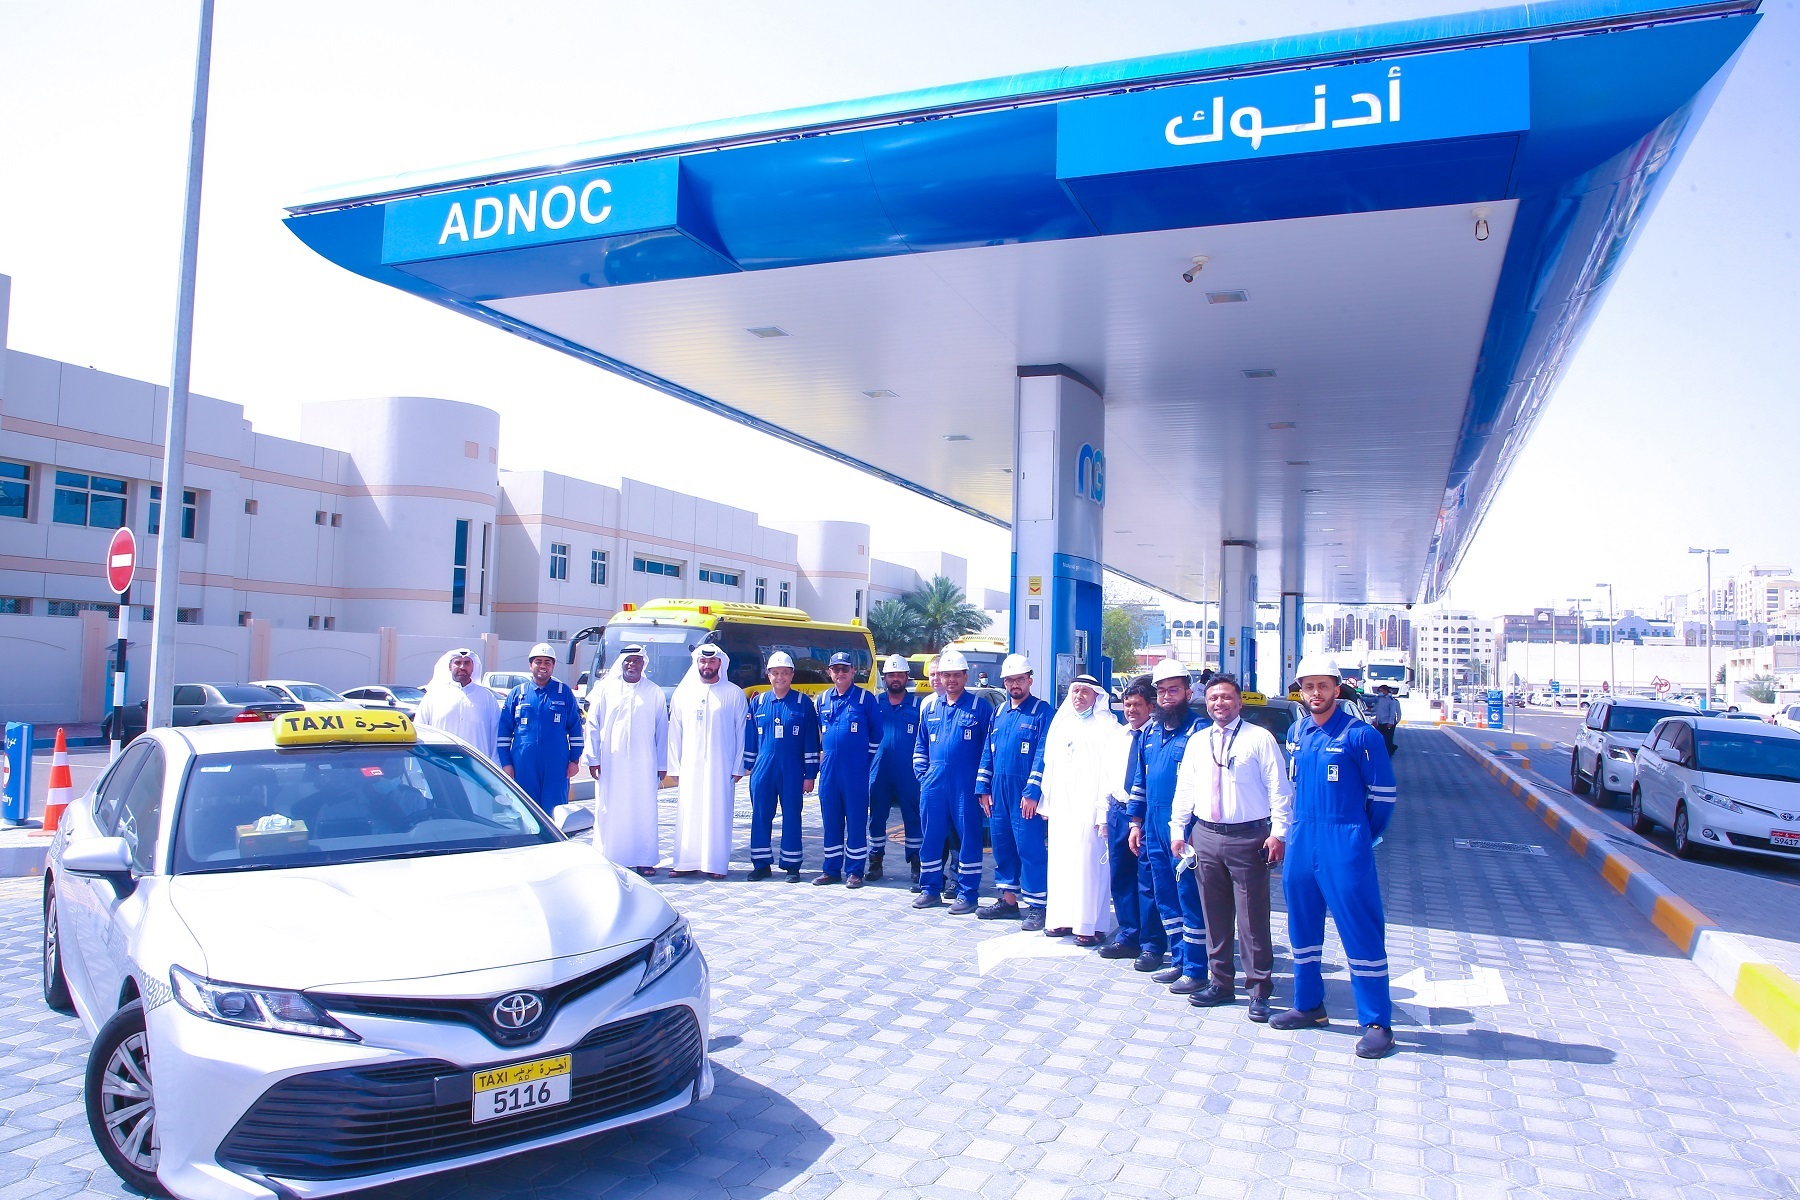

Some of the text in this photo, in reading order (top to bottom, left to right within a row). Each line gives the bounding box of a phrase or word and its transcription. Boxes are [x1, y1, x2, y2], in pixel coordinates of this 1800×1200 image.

[1165, 66, 1401, 150] أدنوك
[438, 179, 612, 245] ADNOC
[285, 716, 345, 731] TAXI
[354, 715, 408, 732] أجرة
[1774, 837, 1799, 846] 59417
[539, 1058, 567, 1076] أجرة
[479, 1071, 508, 1087] TAXI
[493, 1081, 551, 1114] 5116
